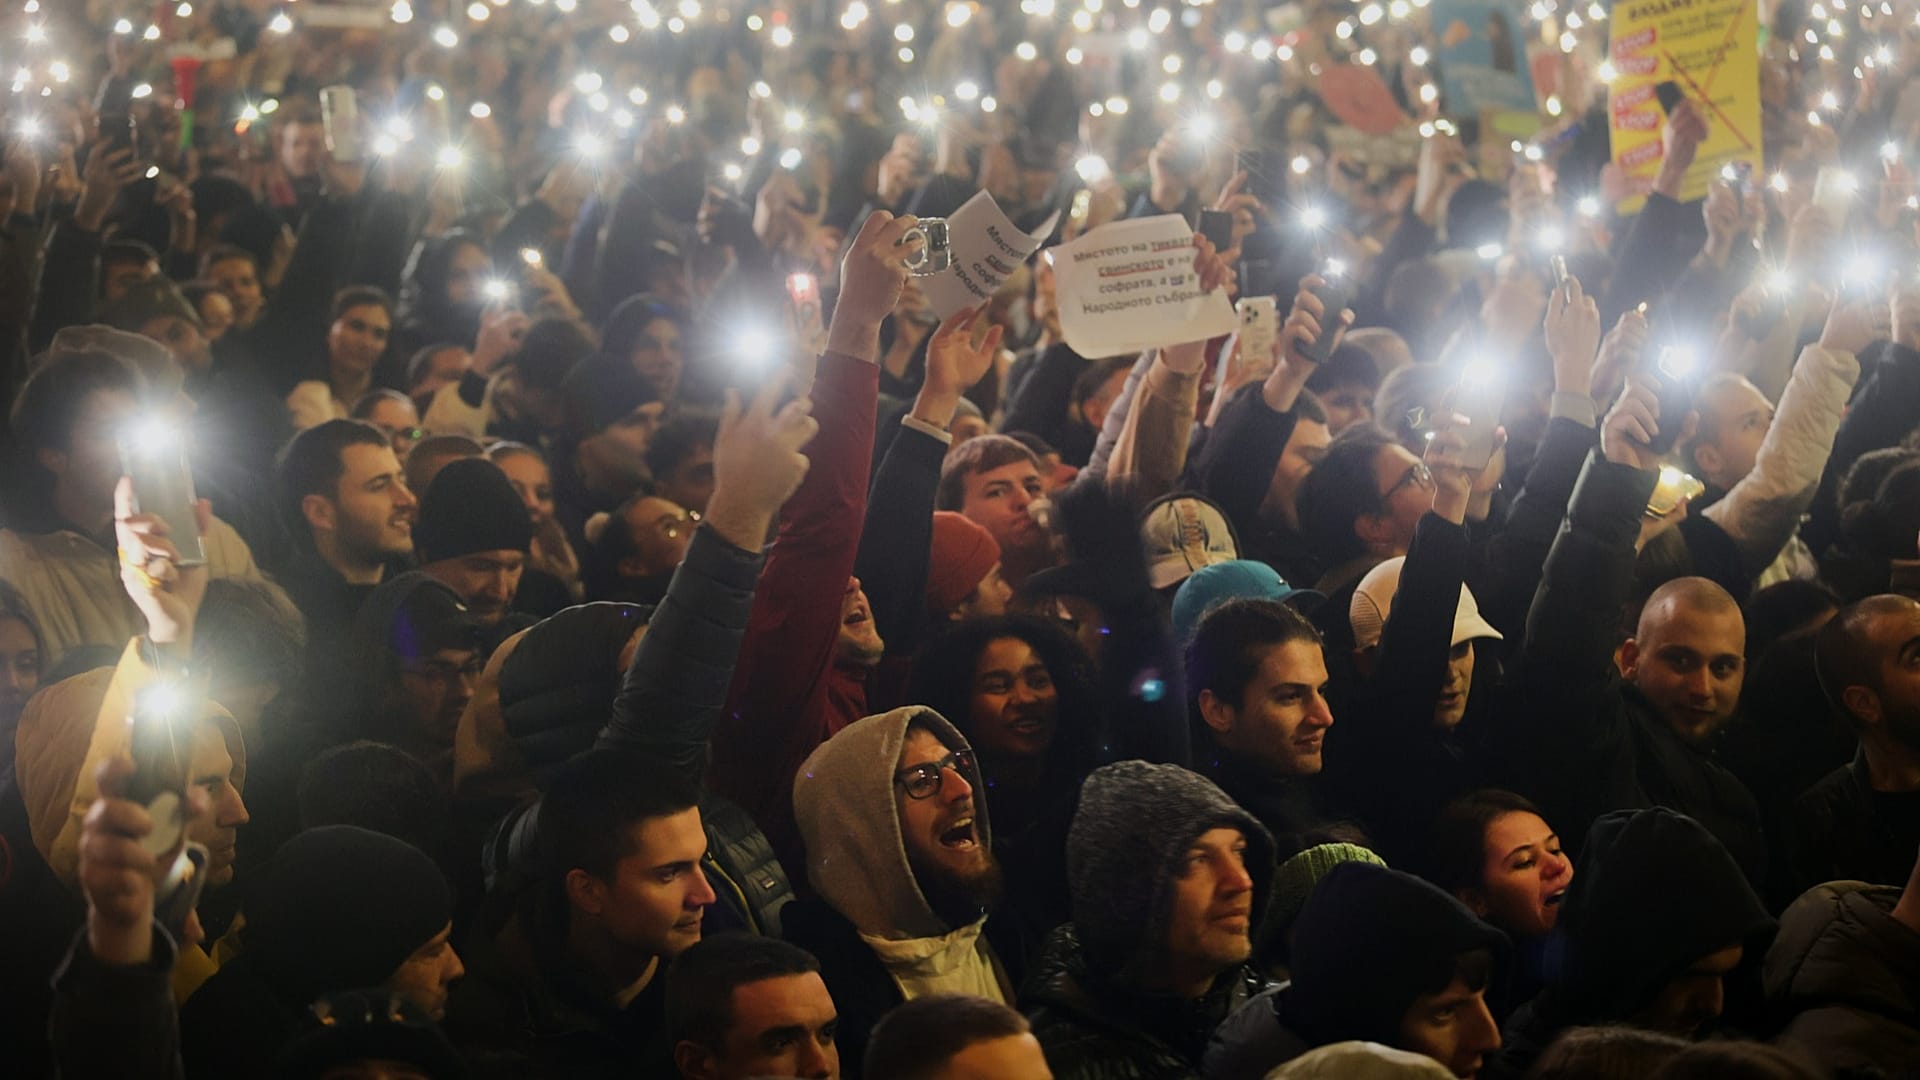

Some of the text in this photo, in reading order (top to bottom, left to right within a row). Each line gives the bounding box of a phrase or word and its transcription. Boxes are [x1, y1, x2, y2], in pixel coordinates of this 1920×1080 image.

[1133, 242, 1148, 251] на
[1151, 237, 1194, 251] тикват
[1168, 257, 1175, 267] е
[1160, 277, 1167, 286] а
[1083, 296, 1152, 314] Народното
